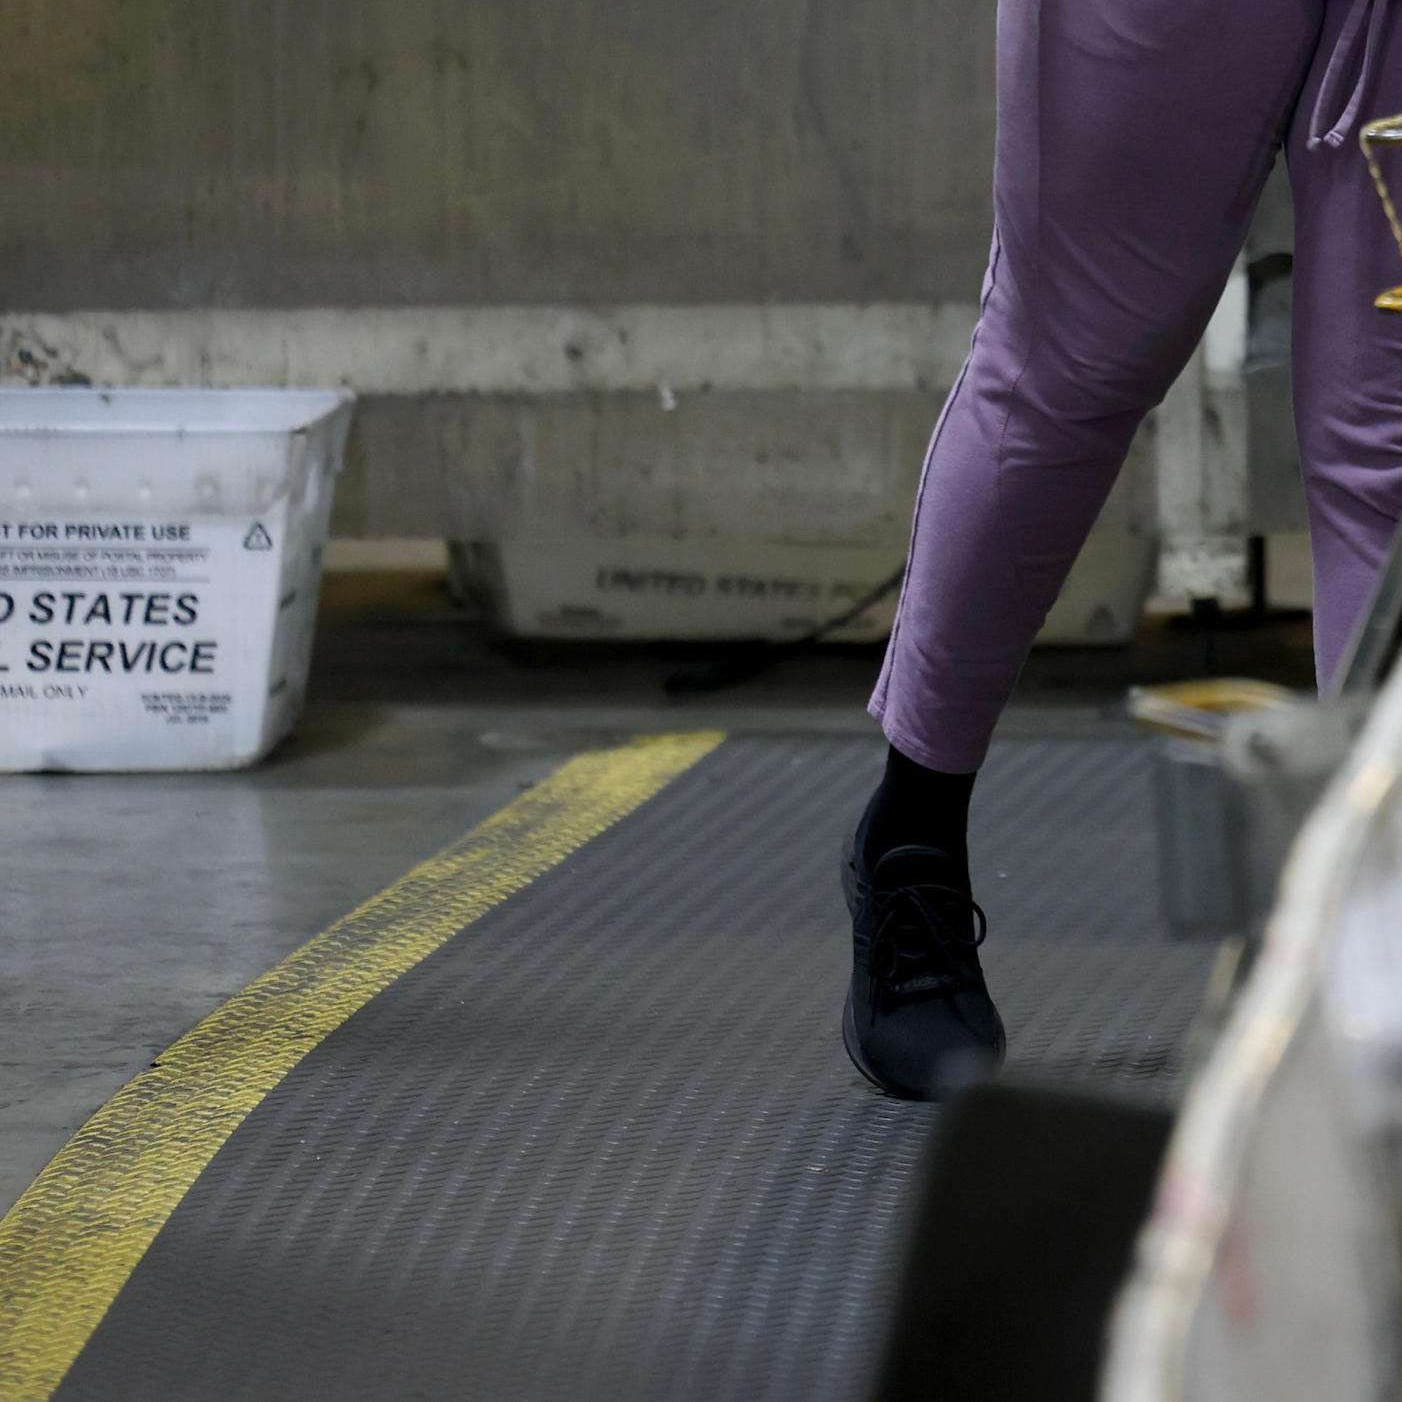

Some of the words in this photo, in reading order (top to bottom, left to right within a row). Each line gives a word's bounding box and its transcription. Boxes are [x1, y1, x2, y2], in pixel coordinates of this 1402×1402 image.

[18, 525, 59, 540] FOR
[65, 525, 146, 540] PRIVATE
[152, 526, 191, 541] USE
[28, 591, 201, 626] STATES
[25, 639, 219, 675] SERVICE
[0, 685, 39, 700] MAIL
[43, 685, 89, 700] ONLY
